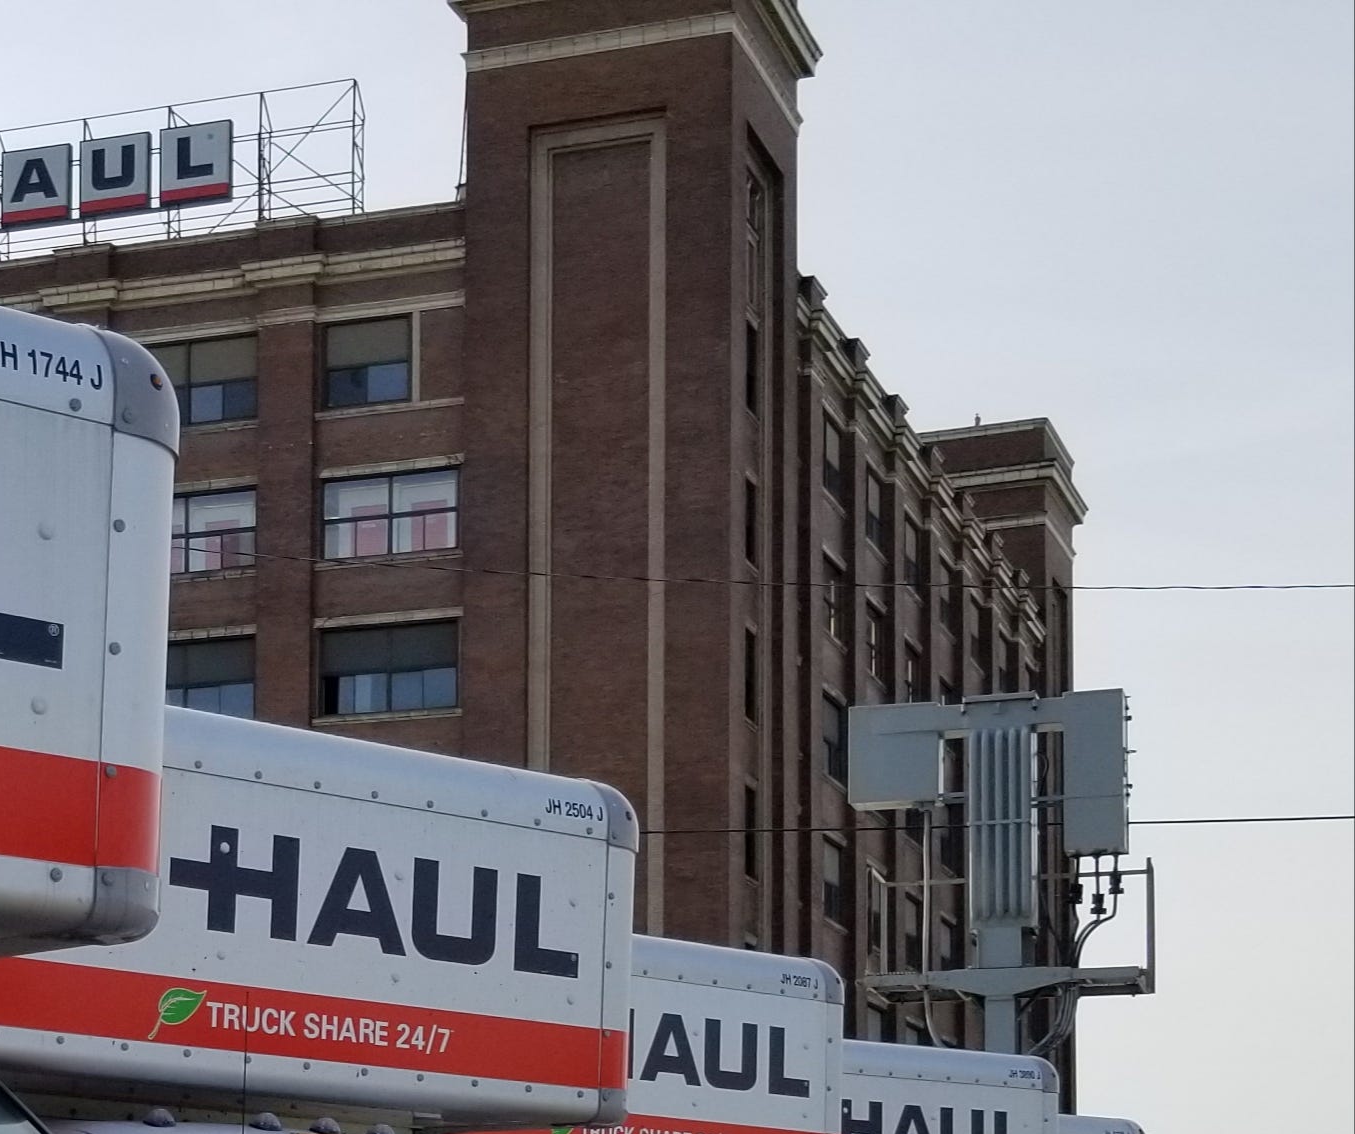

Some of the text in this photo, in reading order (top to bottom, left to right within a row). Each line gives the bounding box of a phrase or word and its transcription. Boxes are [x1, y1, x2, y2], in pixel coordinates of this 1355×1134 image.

[27, 349, 83, 385] 1744
[90, 364, 103, 390] J
[545, 798, 604, 821] JH 2504 J
[206, 1001, 452, 1054] TRUCK SHARE 24/7
